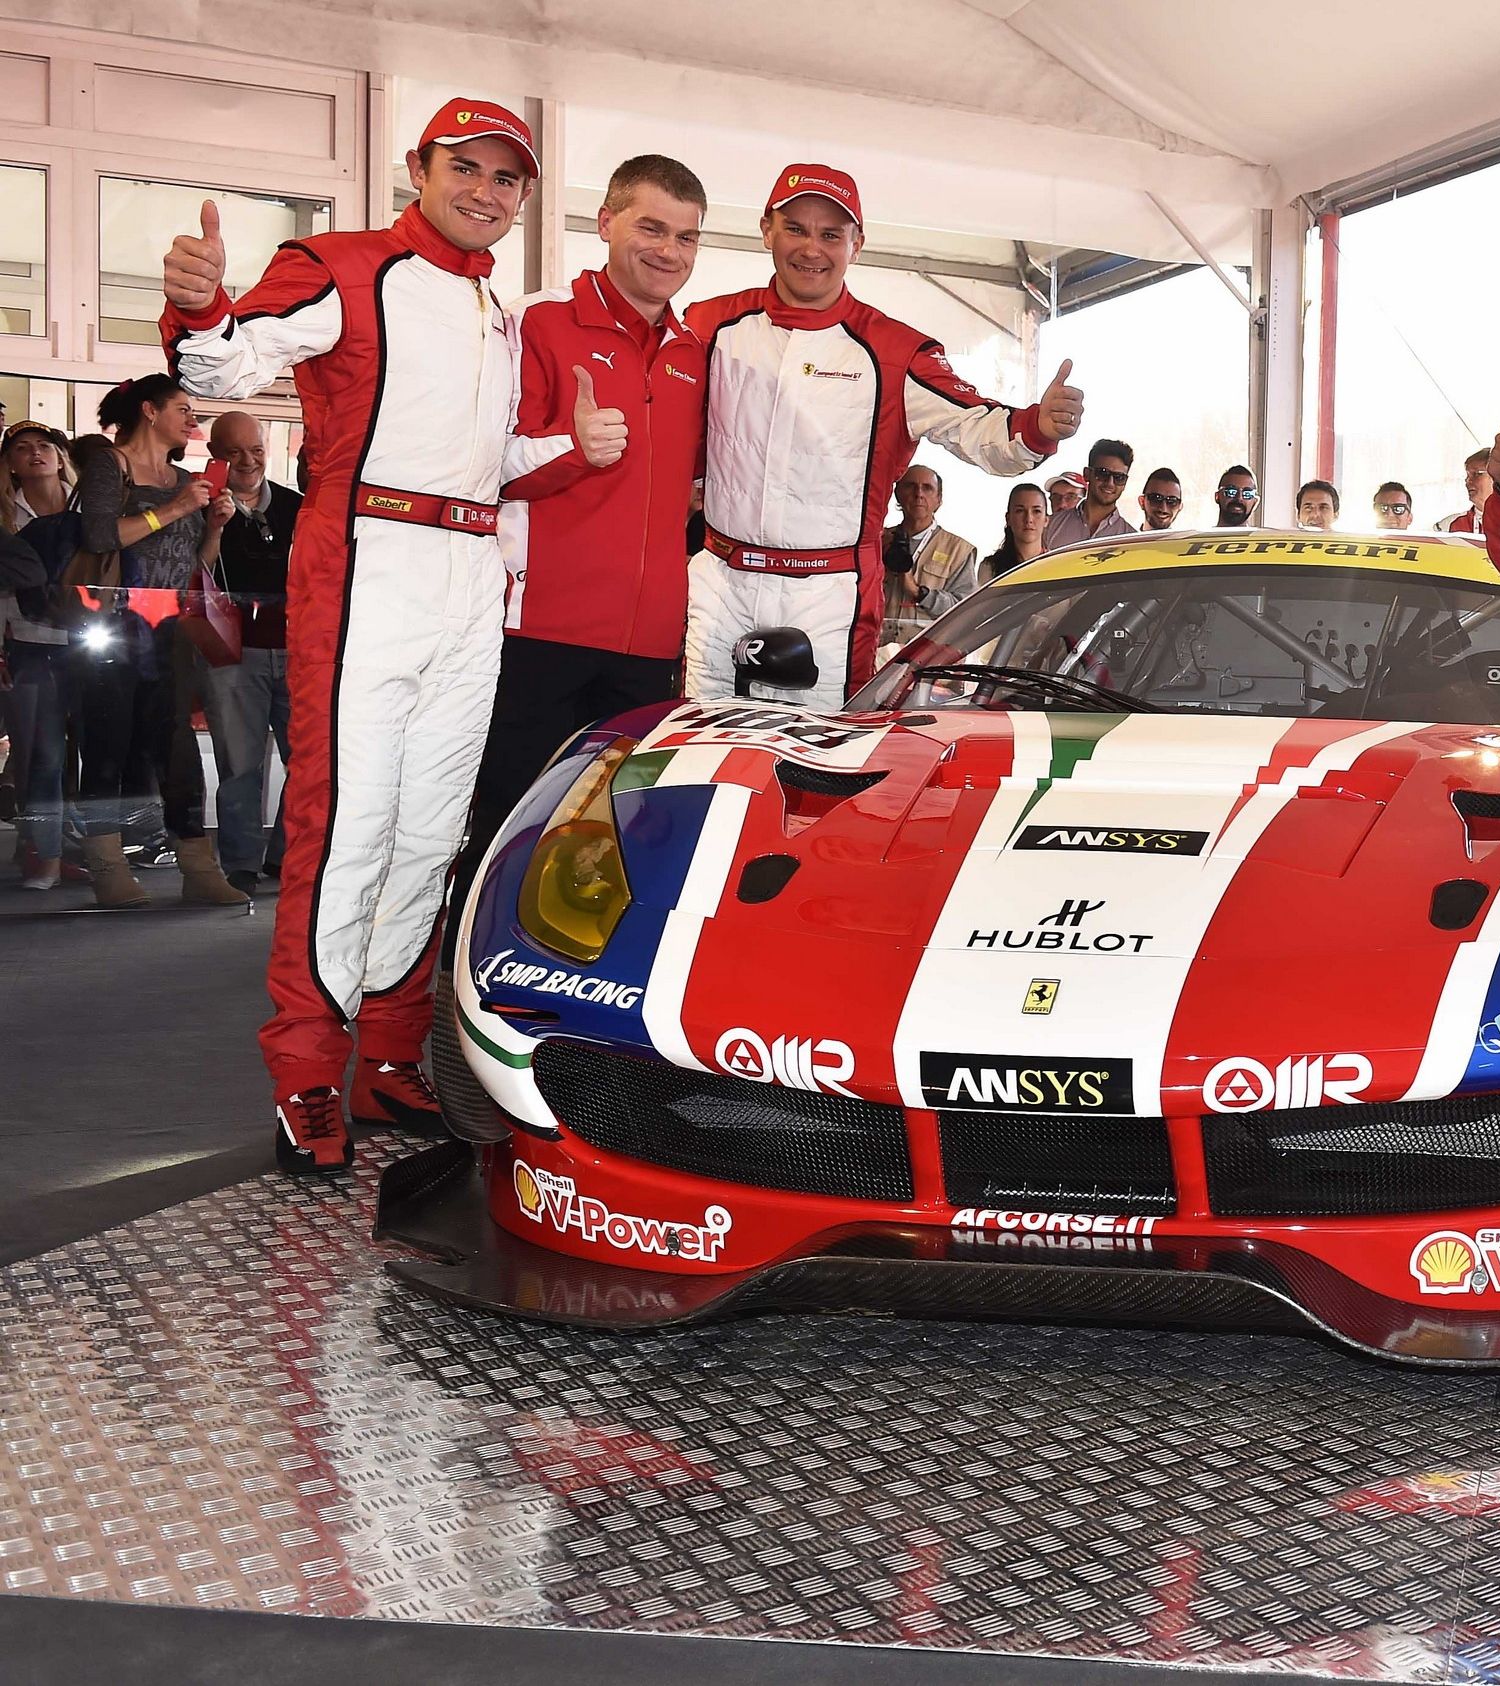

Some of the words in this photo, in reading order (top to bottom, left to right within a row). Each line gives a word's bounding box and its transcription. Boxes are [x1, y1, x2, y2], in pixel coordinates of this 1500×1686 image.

[371, 496, 408, 511] Sabelt
[1177, 541, 1419, 562] Ferrari
[783, 558, 830, 568] Vilander
[1036, 830, 1181, 850] ANSYS
[966, 929, 1154, 953] HUBLOT
[493, 961, 549, 988] SMP
[532, 970, 644, 1010] RACING
[947, 1067, 1105, 1106] ANSYS
[538, 1171, 573, 1192] Shell
[543, 1188, 723, 1260] V-Power
[950, 1208, 1164, 1235] AFCORSE.IT
